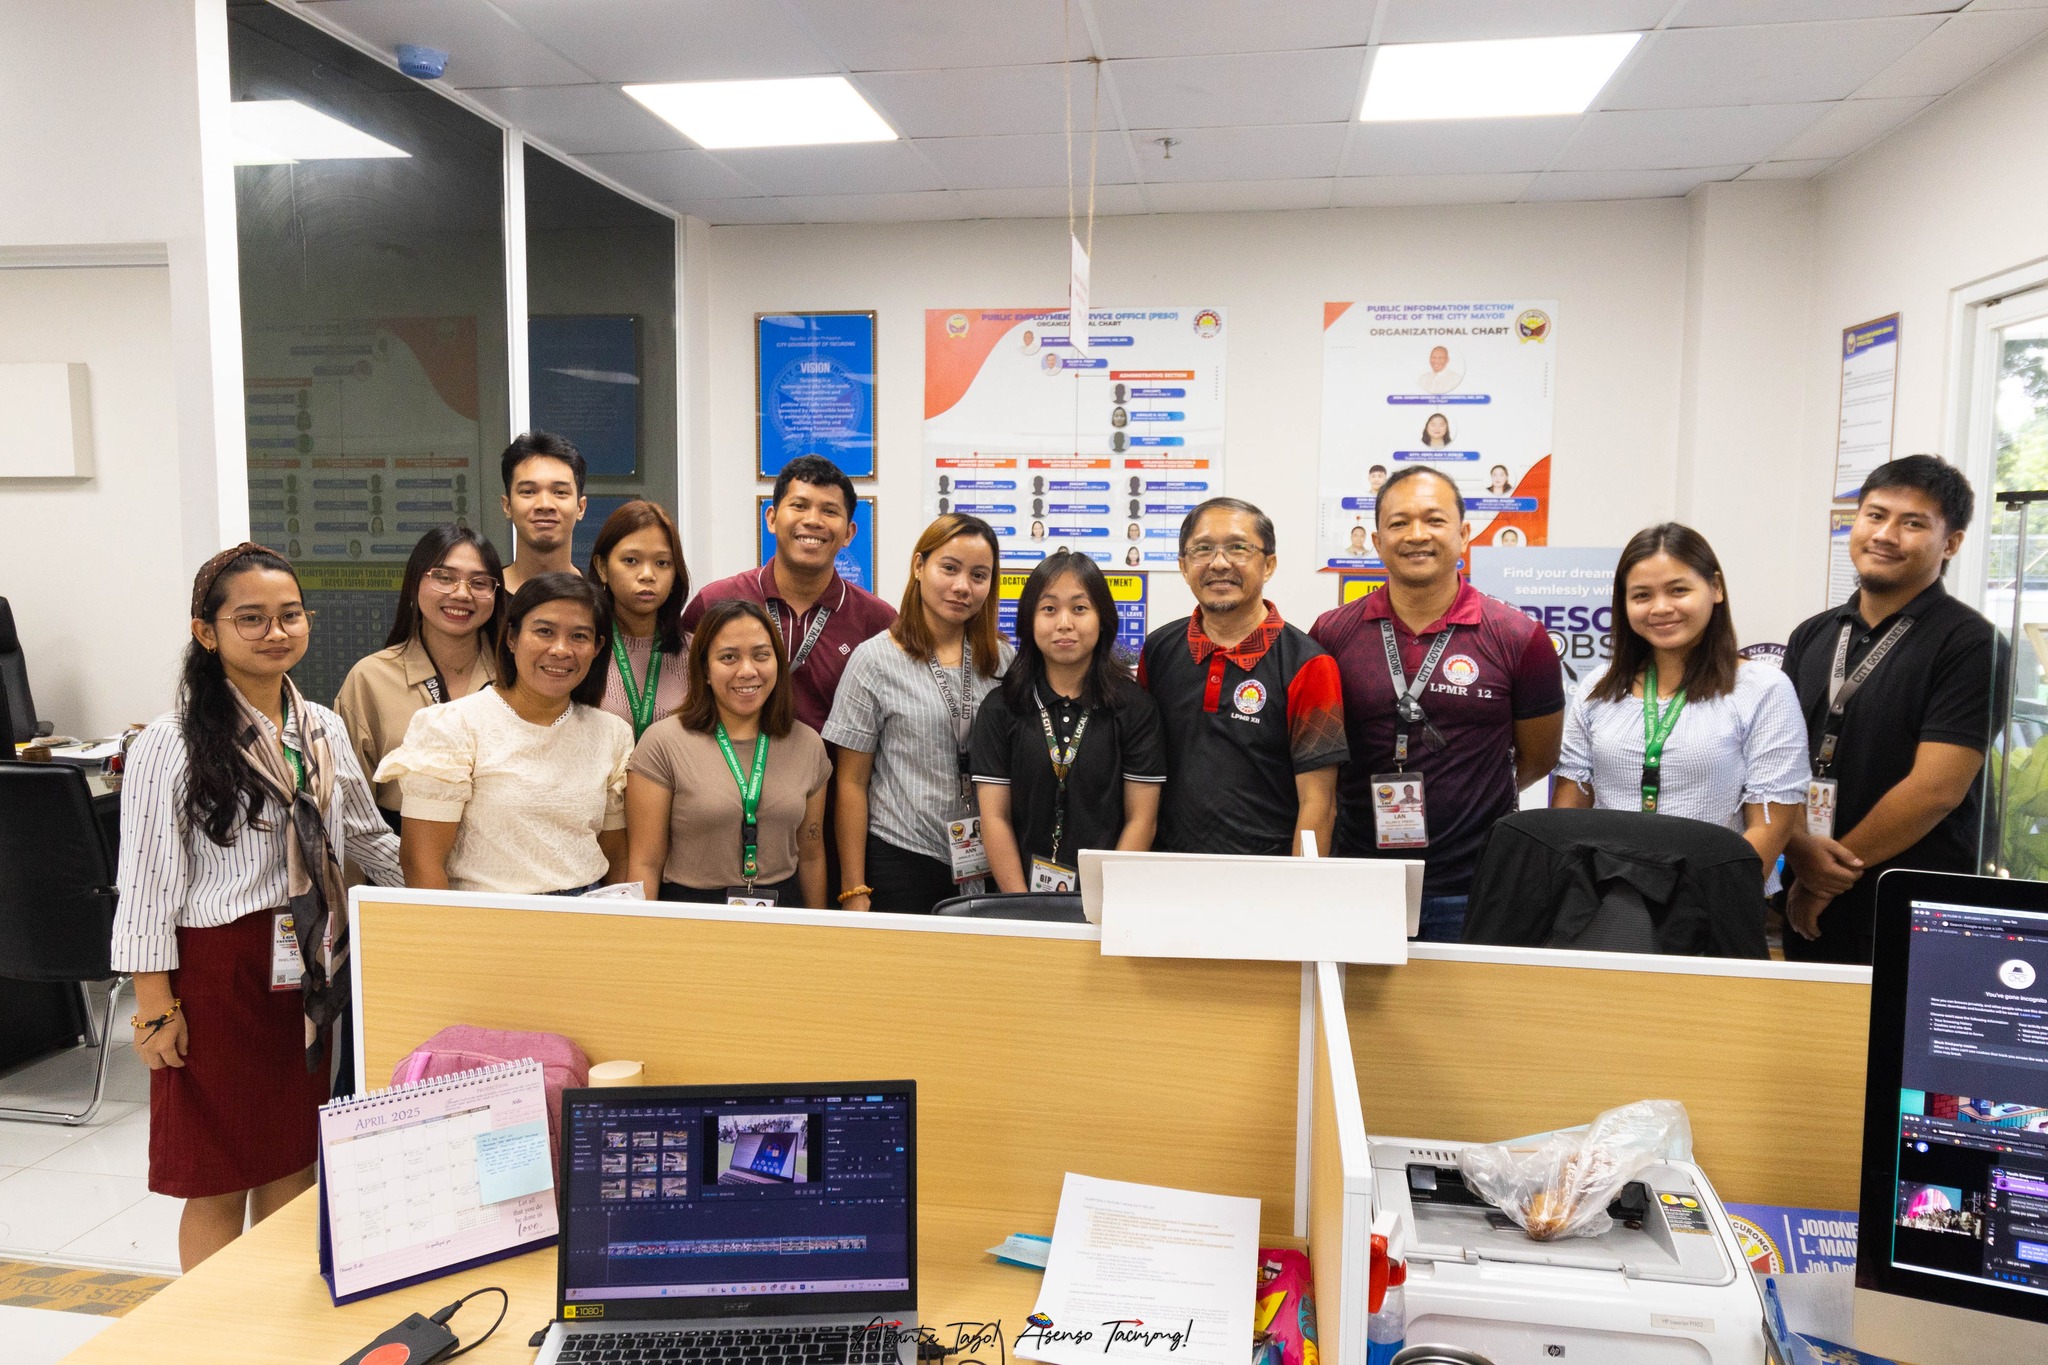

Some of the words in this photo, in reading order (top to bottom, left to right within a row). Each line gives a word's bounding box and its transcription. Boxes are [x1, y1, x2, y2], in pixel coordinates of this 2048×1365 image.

[1367, 304, 1400, 312] PUBLIC
[1403, 304, 1470, 312] INFORMATION
[1473, 303, 1514, 311] SECTION
[1088, 312, 1114, 320] RVICE
[1115, 312, 1146, 320] OFFICE
[1149, 312, 1179, 320] (PESO)
[1470, 312, 1506, 320] MAYOR
[1370, 327, 1468, 336] ORGANIZATIONAL
[1471, 326, 1510, 336] CHART
[800, 362, 830, 374] VISION
[1504, 567, 1533, 578] Find
[1536, 568, 1567, 580] your
[1570, 568, 1615, 578] dream
[1515, 585, 1589, 598] seamlessly
[1593, 586, 1614, 596] wit
[816, 616, 824, 628] OF
[1382, 622, 1392, 632] OF
[796, 627, 820, 663] TACURONG
[1385, 634, 1402, 676] TACURONG
[1834, 638, 1848, 678] TACURONG
[962, 656, 972, 702] GOVERNMENT
[1418, 664, 1433, 682] CITY
[1853, 664, 1871, 682] CITY
[624, 669, 640, 710] Government
[934, 669, 944, 679] OF
[939, 680, 960, 718] TACURONG
[1430, 682, 1468, 696] LPMR
[1478, 688, 1492, 698] 12
[640, 694, 652, 724] Tacurong
[962, 703, 970, 720] CITY
[1230, 712, 1250, 722] LPMR
[1250, 716, 1260, 724] XII
[1043, 718, 1054, 737] CITY
[1074, 716, 1088, 739] LOCAL
[1656, 728, 1668, 742] City
[720, 738, 728, 746] of
[724, 746, 744, 784] Government
[756, 763, 762, 772] of
[748, 772, 762, 800] Tacurong
[1040, 874, 1052, 884] GIP
[355, 1116, 387, 1130] APRIL
[392, 1107, 421, 1122] 2025
[518, 1199, 528, 1207] Let
[512, 1208, 524, 1216] that
[524, 1206, 536, 1214] you
[522, 1214, 536, 1222] done
[1732, 1222, 1770, 1252] CURONG
[1800, 1236, 1815, 1255] L.
[14, 1279, 86, 1300] YOUR
[580, 1306, 599, 1316] 1080
[1548, 1344, 1560, 1357] hp
